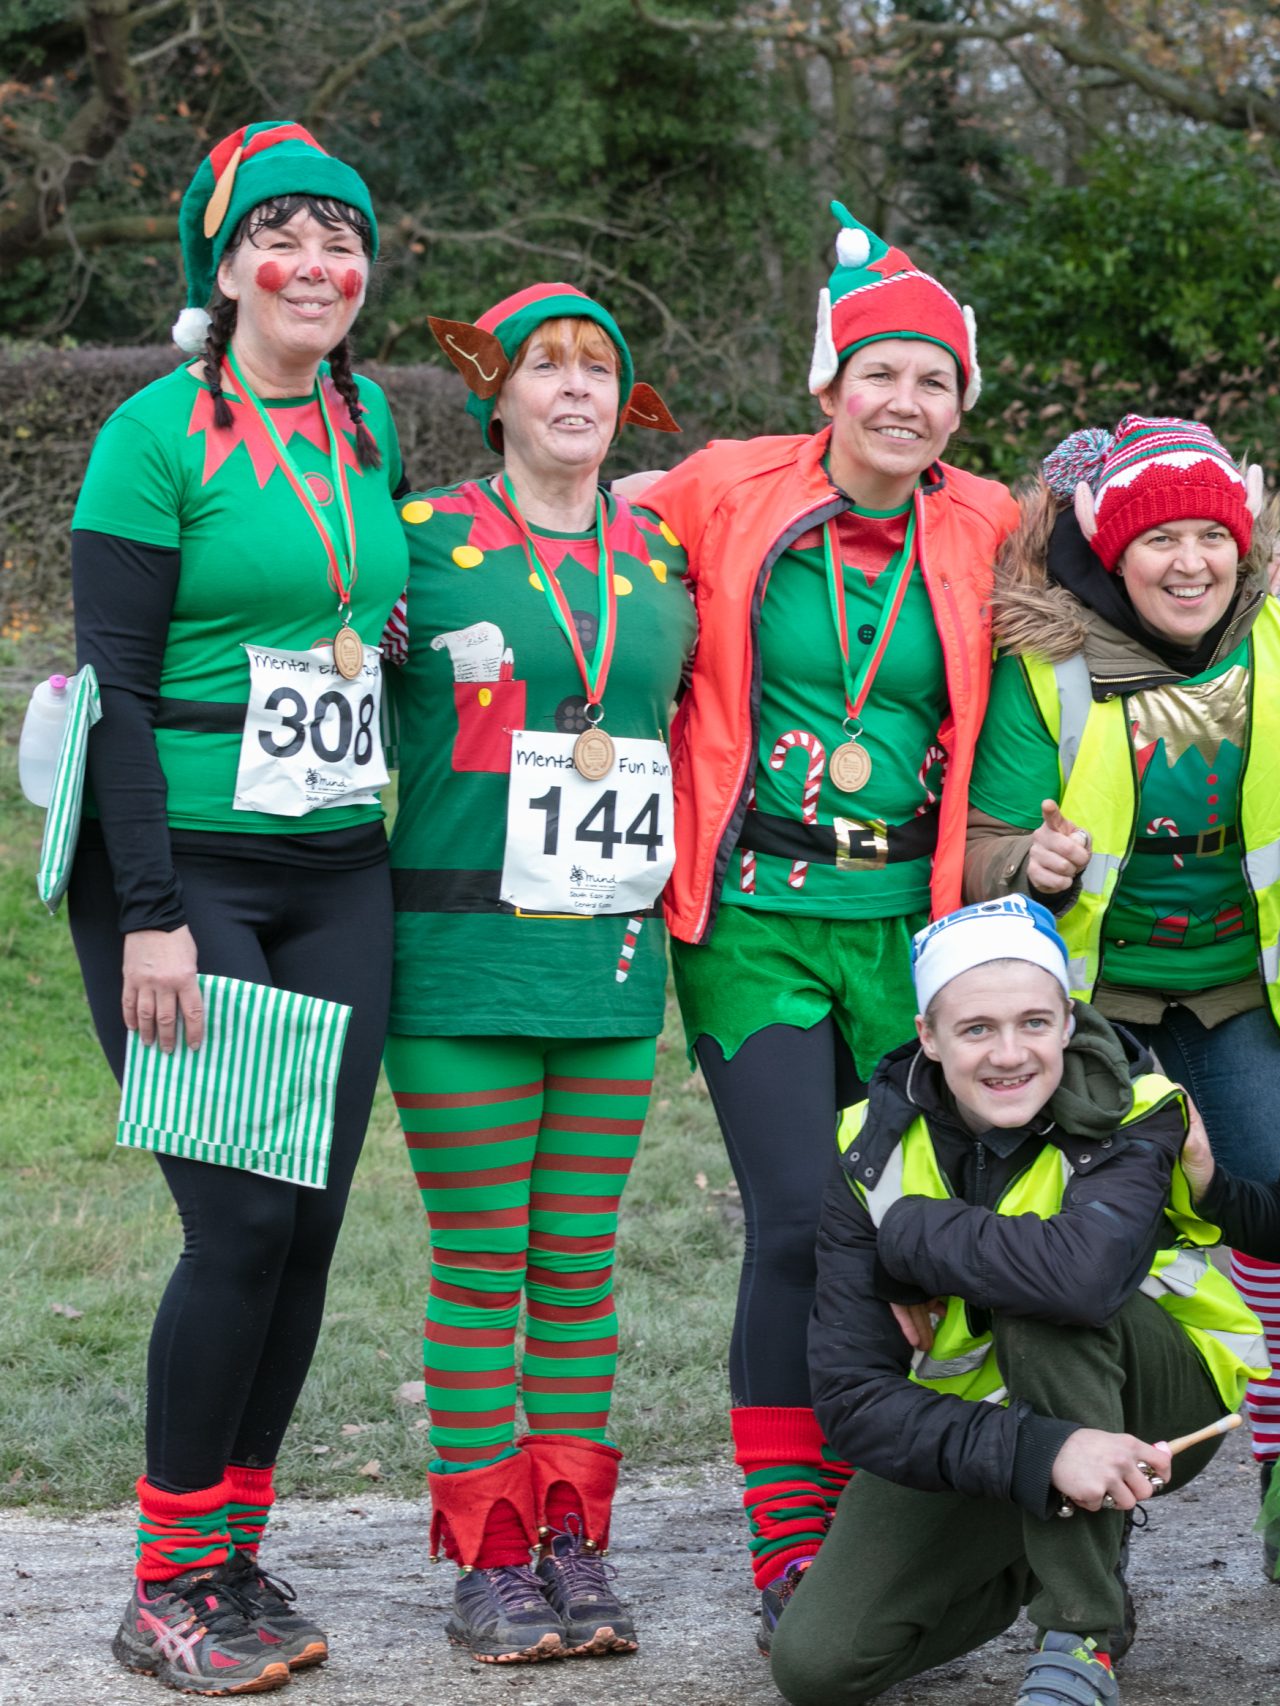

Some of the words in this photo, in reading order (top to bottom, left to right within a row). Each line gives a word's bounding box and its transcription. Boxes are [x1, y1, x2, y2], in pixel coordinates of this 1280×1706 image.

[254, 655, 309, 672] Mental
[258, 687, 374, 766] 308
[618, 758, 646, 774] Fun
[652, 760, 671, 776] Run
[529, 786, 663, 861] 144
[586, 873, 616, 884] mind
